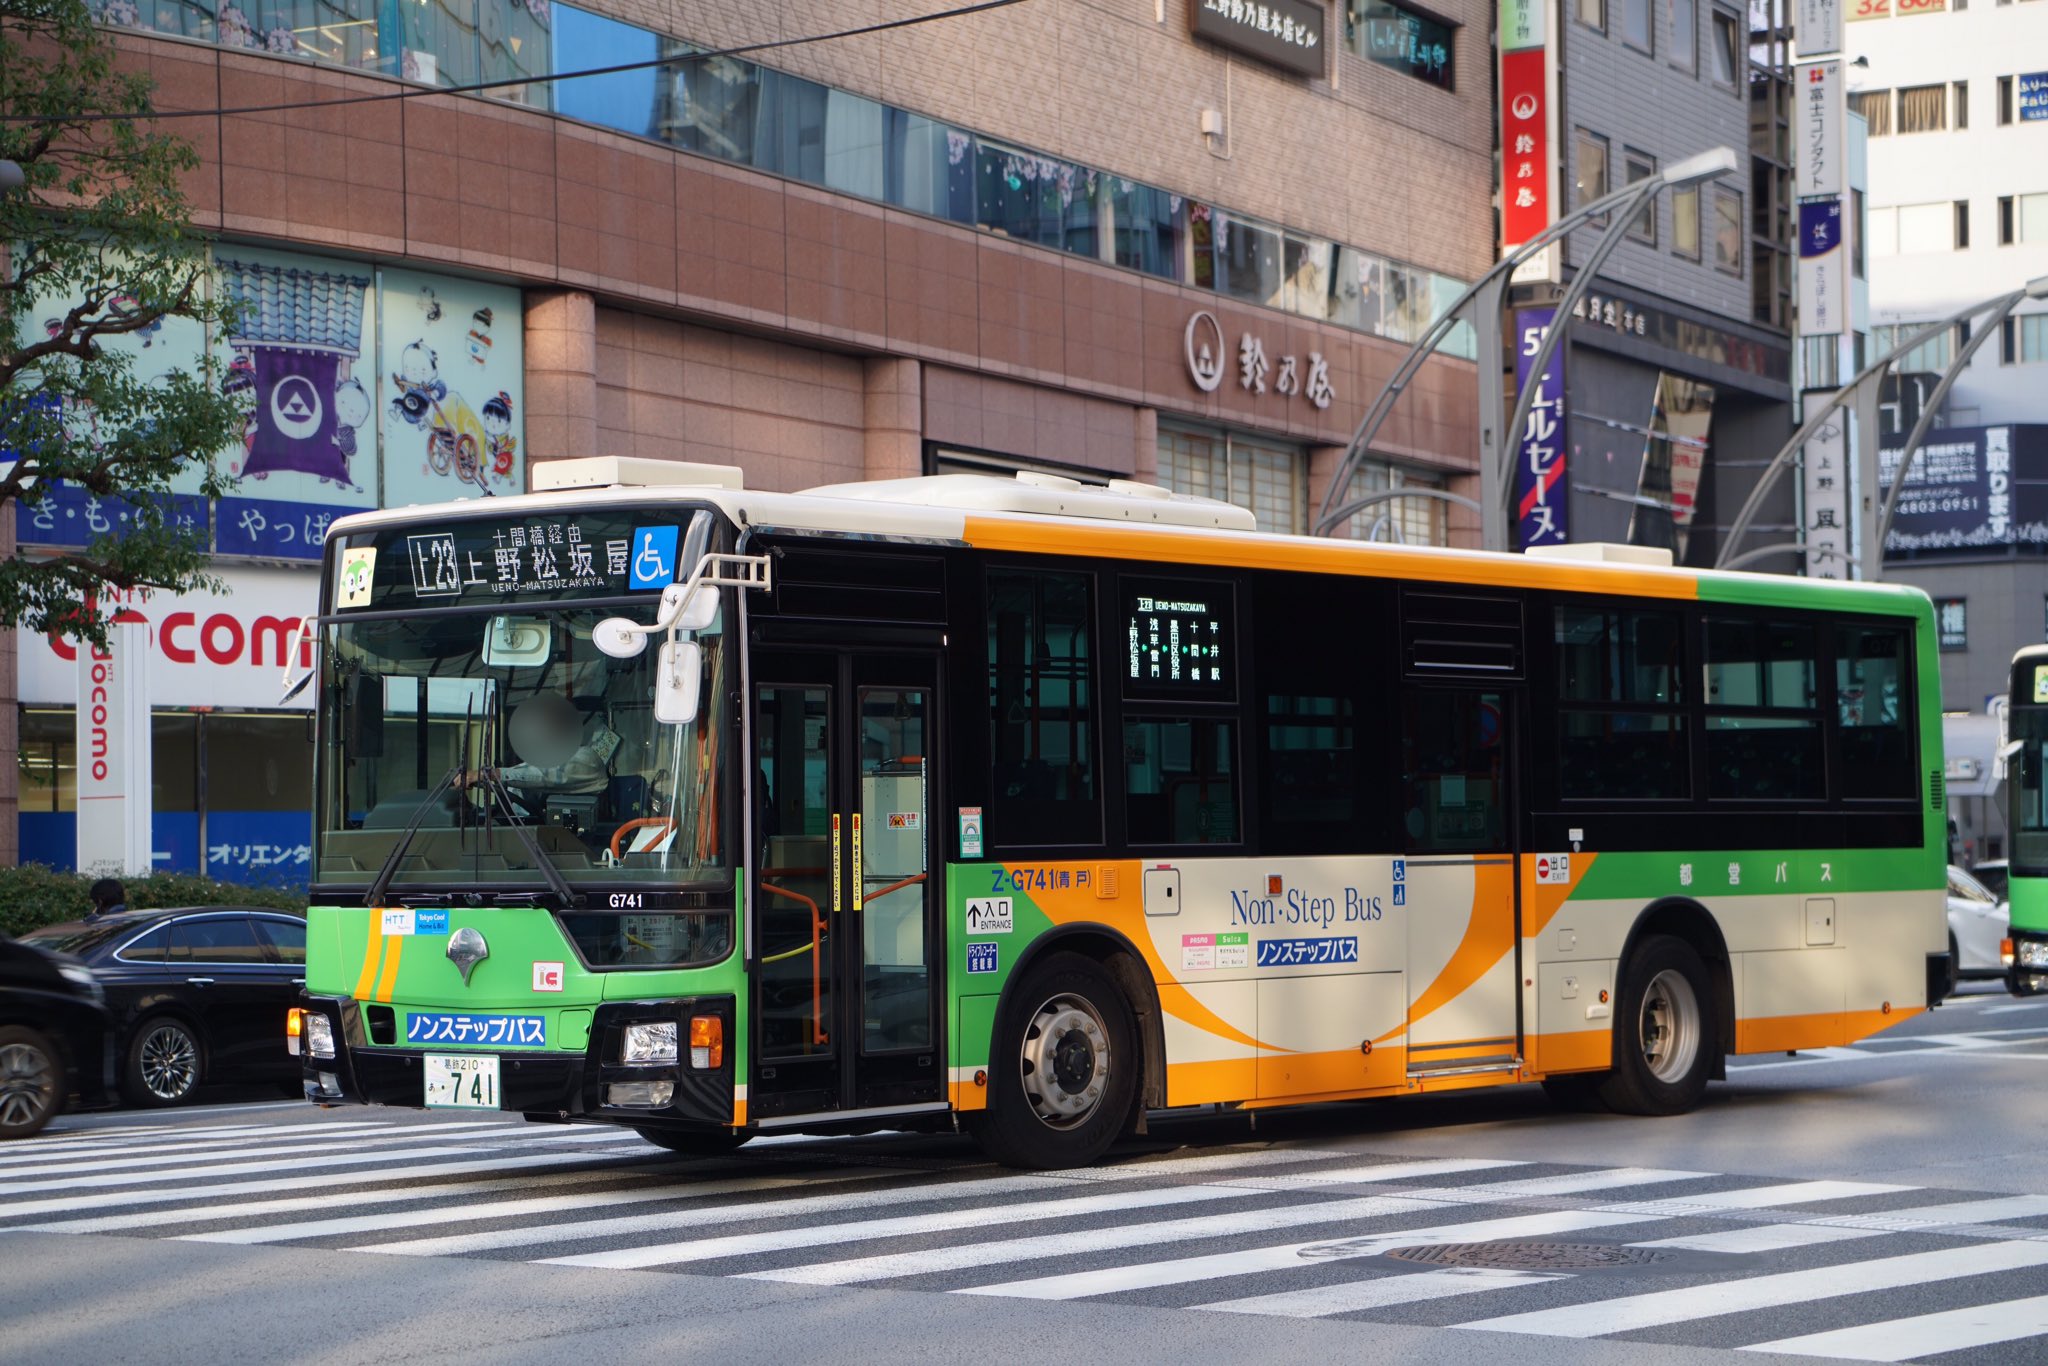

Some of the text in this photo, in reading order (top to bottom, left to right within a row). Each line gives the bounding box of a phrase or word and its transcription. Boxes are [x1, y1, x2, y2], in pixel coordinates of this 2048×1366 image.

[1809, 87, 1824, 189] 富士コンタクト
[493, 524, 581, 547] 十間橋経由
[463, 539, 628, 585] 上野松坂屋
[492, 577, 605, 593] UENO-MATSUZAKAYA
[1155, 601, 1206, 612] UENO-MATSUZAKAYA
[1209, 622, 1220, 680] 平井駅
[1550, 856, 1568, 870] 出口
[1552, 872, 1566, 881] EXIT
[1679, 862, 1832, 886] 都営バス
[609, 893, 643, 908] G741
[1344, 887, 1383, 922] Bus
[419, 913, 445, 922] Tokyo Cool
[984, 902, 1008, 917] 入口
[981, 919, 1012, 930] ENTRANCE
[1222, 935, 1242, 943] Suica
[1257, 938, 1358, 965] ノンステップバス
[408, 1016, 545, 1044] ノンステップバス
